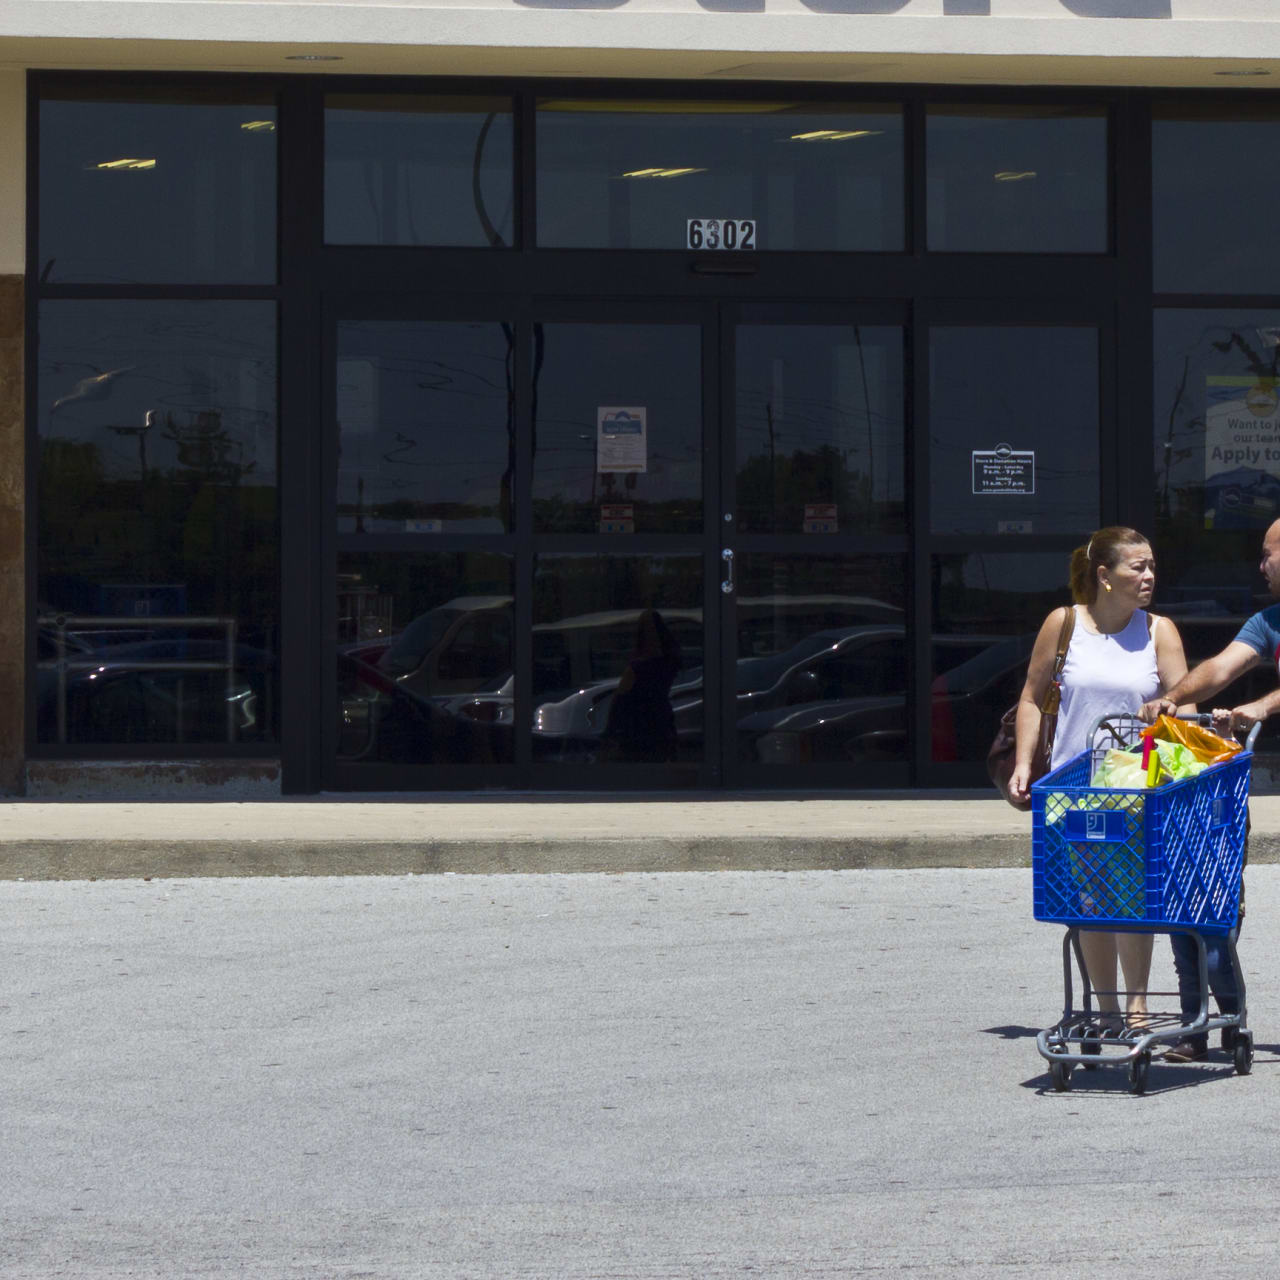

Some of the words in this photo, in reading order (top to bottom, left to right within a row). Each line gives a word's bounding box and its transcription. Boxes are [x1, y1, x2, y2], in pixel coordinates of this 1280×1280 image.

[689, 220, 754, 249] 6302
[1227, 418, 1257, 430] Want
[1260, 419, 1271, 430] to
[1233, 434, 1252, 443] our
[1211, 446, 1261, 464] Apply
